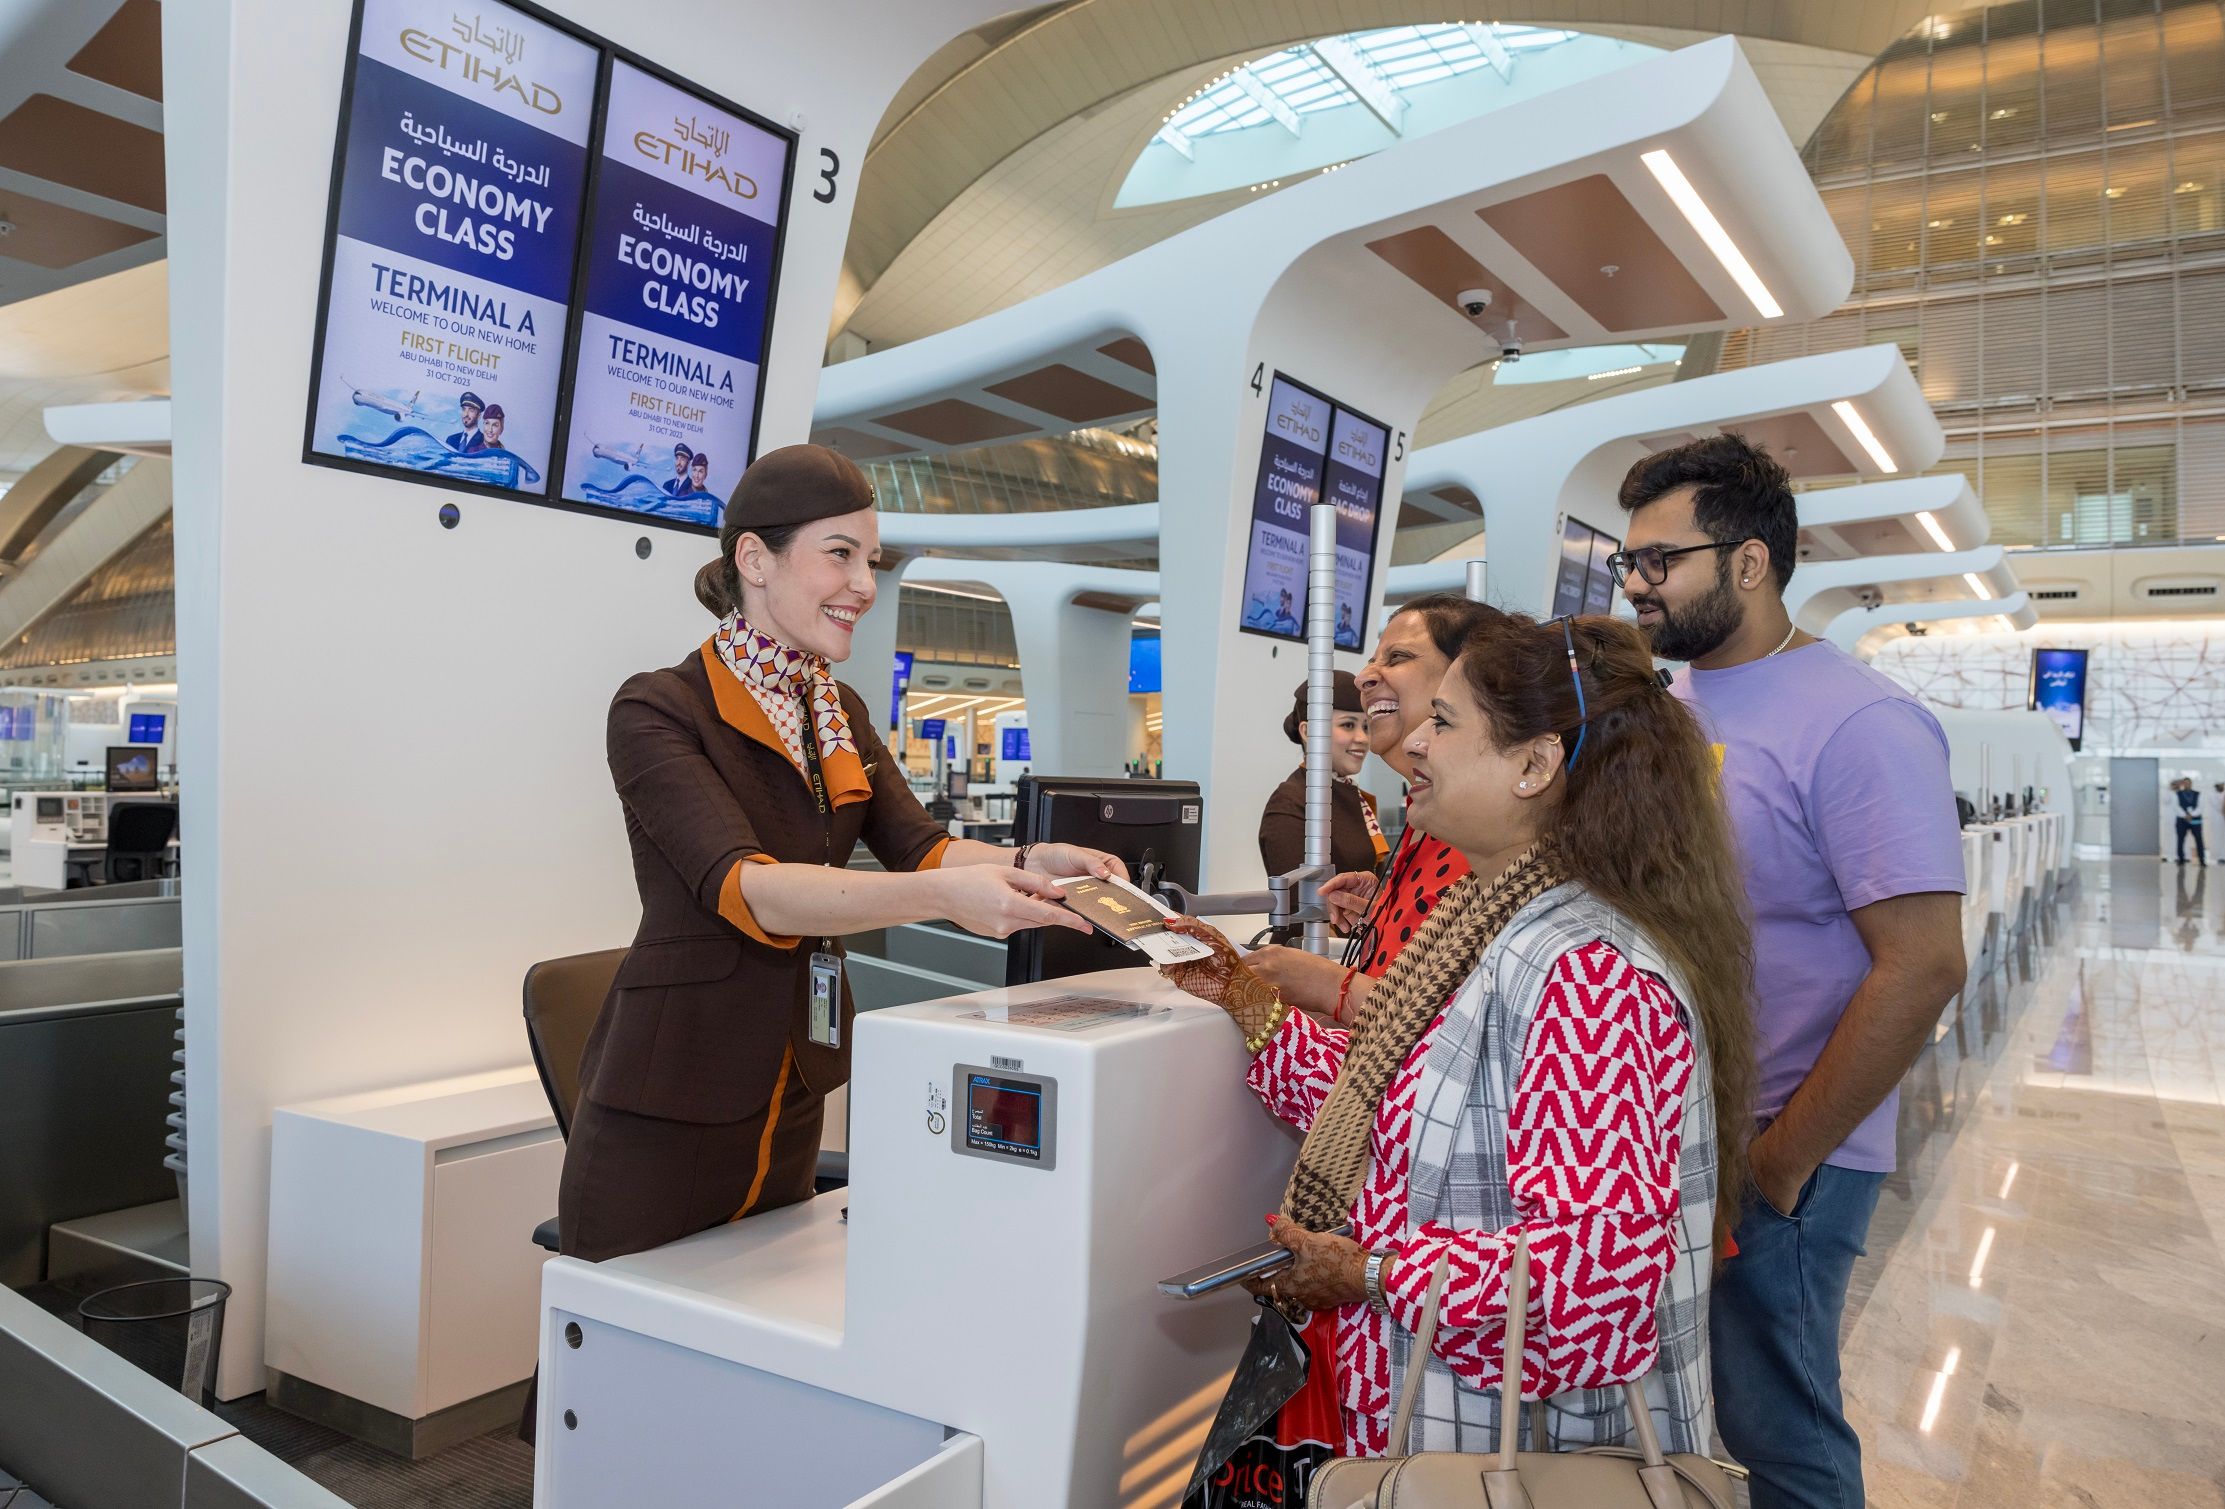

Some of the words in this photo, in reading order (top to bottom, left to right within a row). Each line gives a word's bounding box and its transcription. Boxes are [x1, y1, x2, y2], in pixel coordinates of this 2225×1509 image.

[400, 28, 562, 114] ETIHAD
[400, 111, 488, 164] السياحية
[493, 148, 550, 187] الدرجة
[634, 132, 758, 200] ETIHAD
[813, 147, 840, 204] 3
[382, 146, 553, 234] ECONOMY
[415, 203, 515, 261] CLASS
[633, 203, 700, 245] السياحية
[703, 230, 748, 263] الدرجة
[618, 234, 749, 303] ECONOMY
[372, 263, 511, 329] TERMINAL
[517, 310, 535, 337] A
[643, 281, 719, 328] CLASS
[371, 298, 429, 325] WELCOME
[433, 316, 448, 330] TO
[451, 322, 475, 338] OUR
[478, 329, 503, 345] NEW
[506, 337, 537, 354] HOME
[400, 351, 417, 361] ABU
[419, 355, 443, 368] DHABI
[443, 362, 455, 371] TO
[457, 364, 475, 376] NEW
[476, 370, 498, 382] DELHI
[402, 330, 445, 355] FIRST
[448, 343, 501, 370] FLIGHT
[609, 334, 715, 388] TERMINAL
[720, 370, 734, 393] A
[426, 369, 433, 377] 31
[436, 372, 451, 382] OCT
[454, 376, 471, 387] 2023
[608, 365, 652, 386] WELCOME
[655, 378, 666, 390] TO
[669, 383, 688, 398] OUR
[689, 389, 709, 401] NEW
[711, 394, 734, 409] HOME
[1251, 362, 1264, 398] 4
[629, 409, 642, 418] ABU
[643, 412, 662, 423] DHABI
[663, 417, 671, 425] TO
[672, 420, 687, 430] NEW
[688, 423, 703, 434] DELHI
[630, 392, 663, 411] FIRST
[666, 402, 707, 423] FLIGHT
[656, 426, 668, 435] OCT
[669, 429, 683, 439] 2023
[1277, 414, 1320, 442] ETIHAD
[1395, 432, 1406, 462] 5
[1338, 441, 1376, 467] ETIHAD
[1267, 473, 1314, 503] ECONOMY
[1275, 497, 1302, 520] CLASS
[1348, 503, 1370, 523] DROP
[1262, 530, 1300, 555] TERMINAL
[1300, 543, 1305, 556] A
[813, 773, 826, 814] ETIHAD
